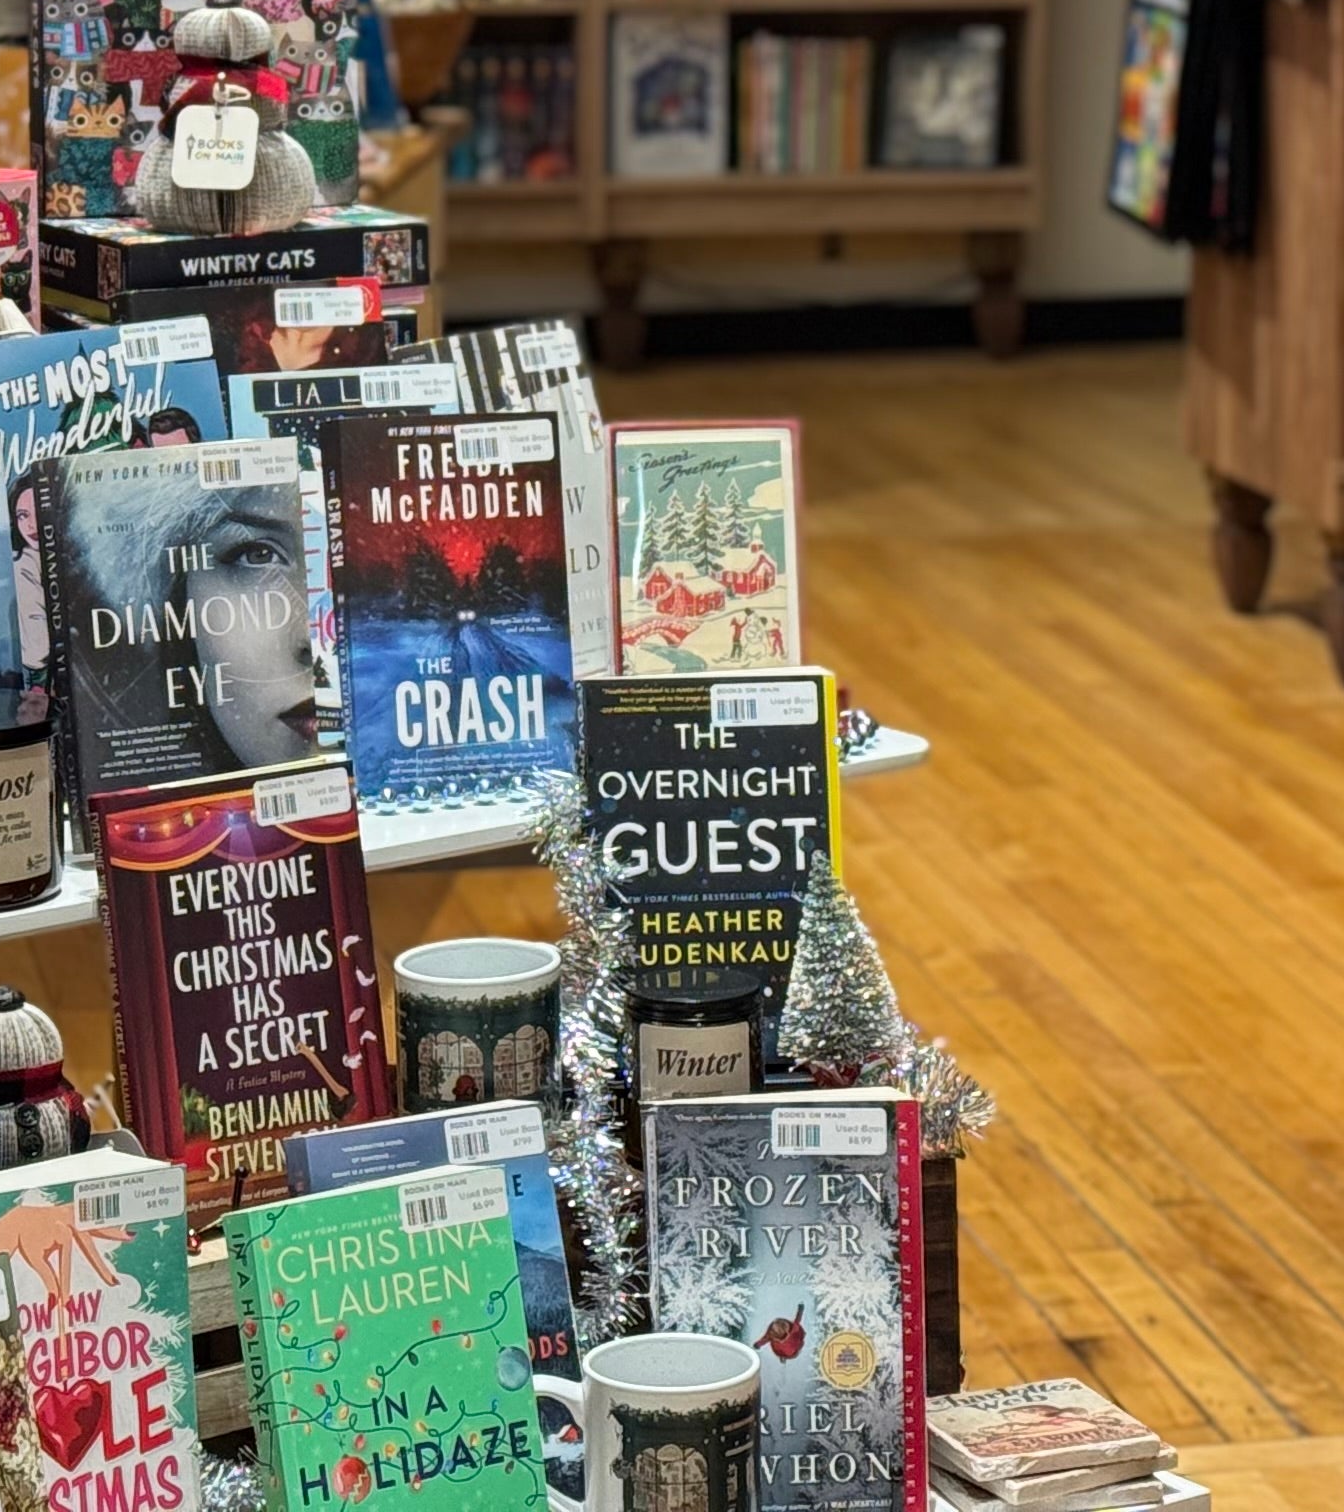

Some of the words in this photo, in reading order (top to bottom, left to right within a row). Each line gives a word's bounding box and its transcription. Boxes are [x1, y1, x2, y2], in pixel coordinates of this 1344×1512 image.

[195, 151, 213, 161] ON
[216, 150, 245, 161] MAIN
[197, 138, 245, 151] BOOKS
[181, 252, 260, 277] WINTRY
[267, 249, 316, 271] CATS
[44, 344, 128, 409] MOST
[273, 381, 322, 407] LIA
[6, 362, 173, 487] Wonderful
[74, 468, 104, 484] NEW
[112, 466, 150, 481] YORK
[158, 460, 199, 475] TIMES
[659, 455, 740, 494] Greetings
[370, 481, 544, 524] McFADDEN
[327, 497, 345, 568] CRASH
[43, 524, 63, 631] DIAMOND
[164, 543, 216, 574] THE
[91, 590, 292, 650] DIAMOND
[416, 656, 452, 675] THE
[165, 662, 235, 710] EYE
[395, 674, 547, 748] CRASH
[674, 723, 737, 750] THE
[598, 766, 816, 801] OVERNIGHT
[602, 817, 817, 878] GUEST
[169, 854, 317, 916] EVERYONE
[702, 891, 763, 902] BESTSELLING
[223, 902, 276, 941] THIS
[641, 909, 784, 935] HEATHER
[174, 929, 334, 993] CHRISTMAS
[640, 941, 790, 966] UDENKAU
[232, 979, 286, 1024] HAS
[197, 1032, 219, 1073] A
[225, 1010, 330, 1069] SECRET
[270, 1069, 307, 1086] Mystery
[655, 1048, 743, 1077] Winter
[208, 1088, 331, 1141] BENJAMIN
[79, 1181, 106, 1192] BOOKS
[123, 1176, 144, 1185] MAIN
[674, 1172, 885, 1208] FROZEN
[276, 1221, 492, 1285] CHRISTINA
[699, 1224, 863, 1258] RIVER
[66, 1289, 102, 1323] MY
[311, 1261, 472, 1326] LAUREN
[27, 1322, 152, 1387] GHBOR
[371, 1390, 410, 1427] IN
[424, 1385, 448, 1416] A
[760, 1402, 865, 1436] RIEL
[49, 1455, 184, 1512] STMAS
[761, 1451, 894, 1486] WHON
